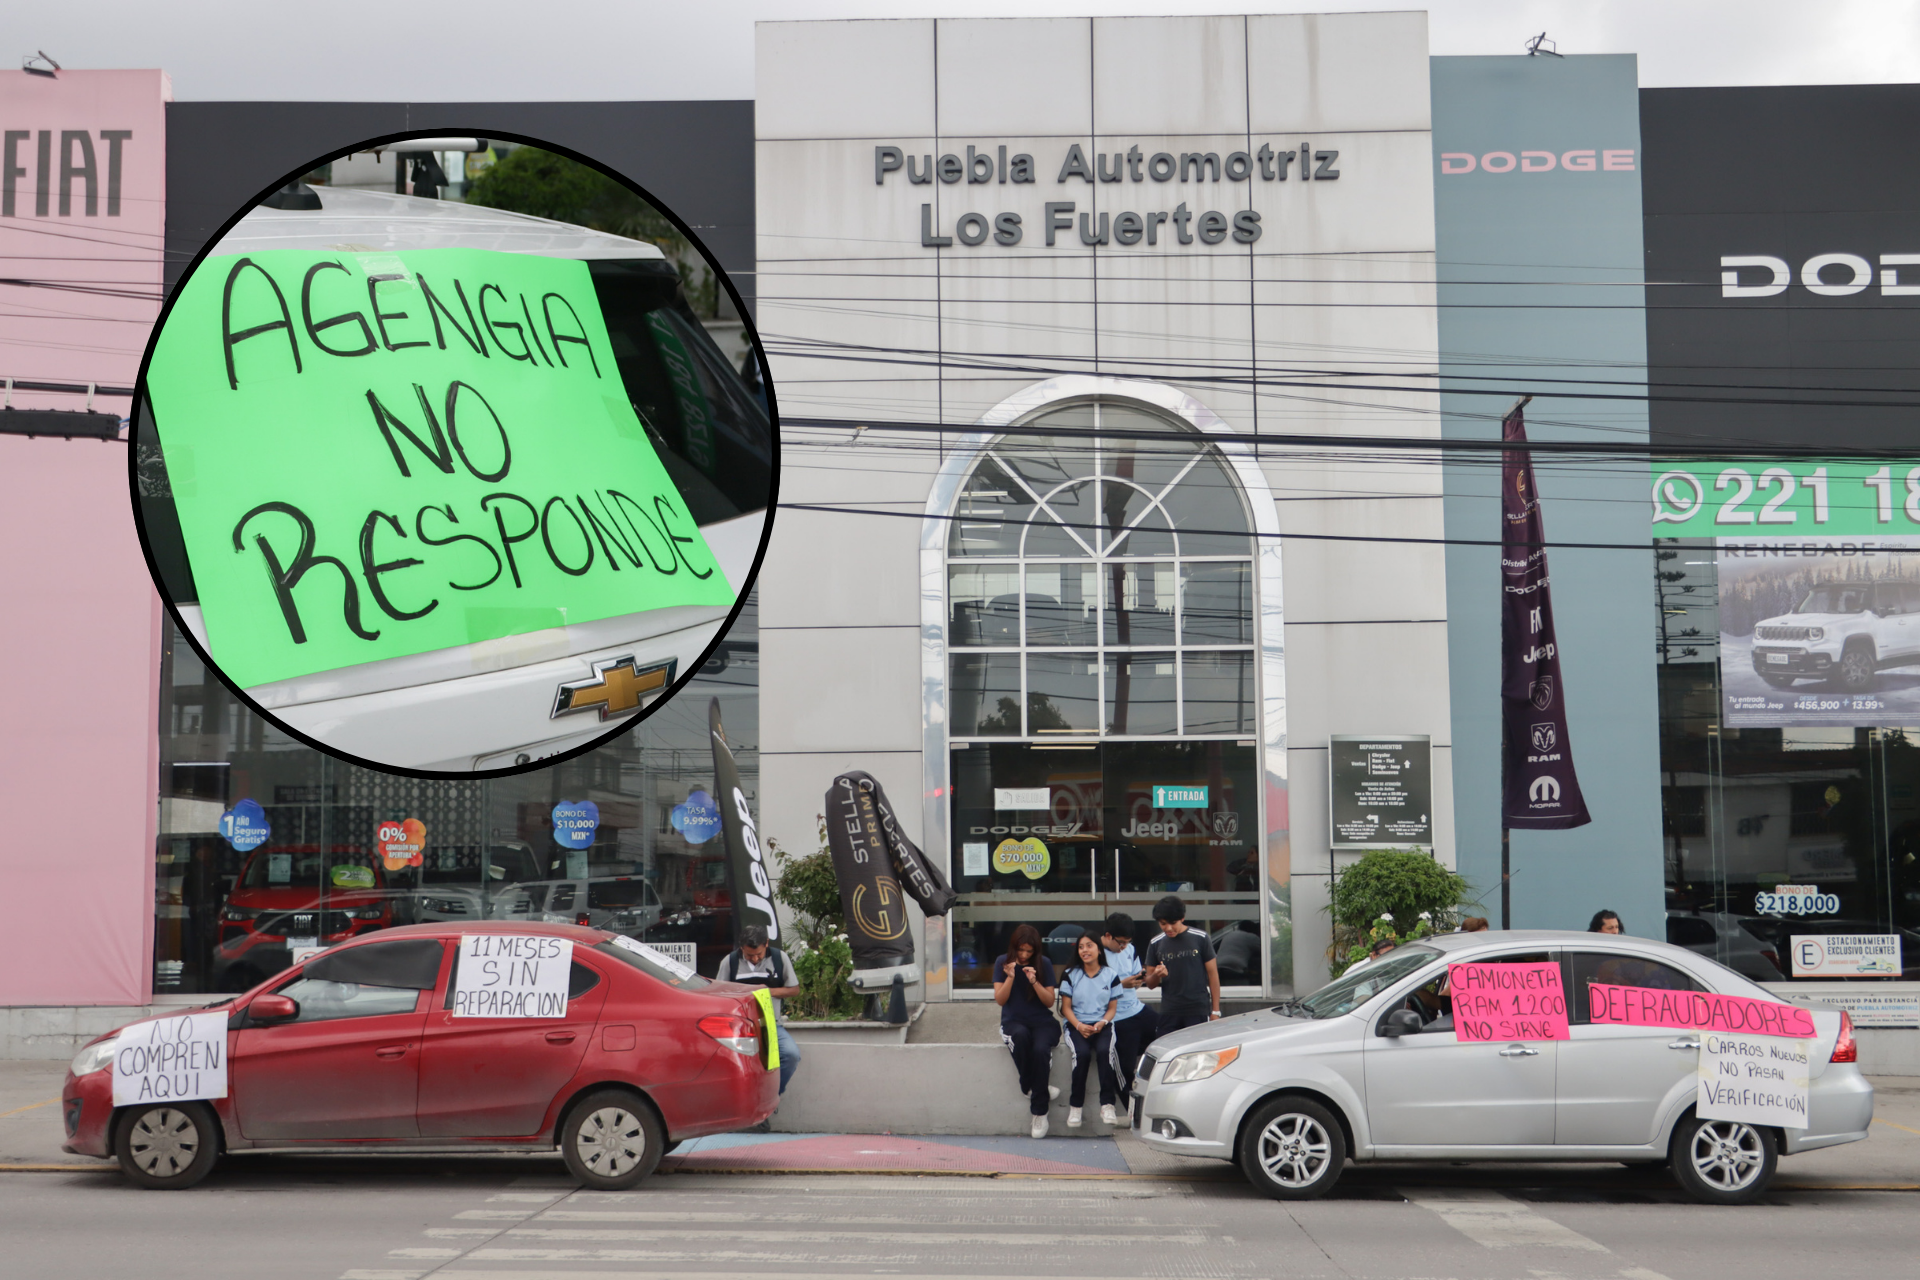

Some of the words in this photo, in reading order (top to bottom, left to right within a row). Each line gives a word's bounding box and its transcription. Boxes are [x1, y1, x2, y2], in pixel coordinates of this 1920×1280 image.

[2, 130, 132, 217] FIAT
[874, 145, 1035, 185] Puebla
[1057, 141, 1340, 184] Automotriz
[1441, 149, 1635, 174] DODGE
[921, 203, 1023, 248] Los
[1044, 201, 1263, 247] Fuertes
[365, 380, 511, 483] NO
[1714, 467, 1830, 525] 221
[1724, 542, 1876, 557] RENEGADE
[231, 489, 713, 645] RESPONDE
[1767, 702, 1784, 710] Jeep
[1794, 701, 1840, 710] $456,900
[1527, 754, 1561, 763] RAM
[1168, 790, 1205, 802] ENTRADA
[223, 815, 234, 837] 1
[234, 827, 267, 837] Seguro
[557, 819, 595, 830] $10,000
[840, 778, 869, 864] STELLA
[970, 826, 1069, 835] DODGE
[1121, 819, 1178, 841] Jeep
[380, 827, 407, 842] 0%
[733, 787, 778, 941] Jeep
[1000, 853, 1043, 863] $70,000
[1776, 886, 1801, 894] BONO
[1803, 886, 1814, 894] DE
[1755, 894, 1836, 916] $218,000
[470, 937, 497, 958] 11
[500, 937, 561, 960] MESES
[1802, 944, 1815, 965] E
[1827, 937, 1895, 945] ESTACIONAMIENTO
[1827, 947, 1863, 955] EXCLUSIVO
[1865, 946, 1895, 955] CLIENTES
[483, 961, 538, 986] SIN
[1449, 966, 1558, 992] CAMIONETA
[455, 990, 565, 1017] REPARACION
[1458, 994, 1501, 1018] RAM
[1512, 991, 1564, 1017] 1200
[1592, 987, 1815, 1036] DEFRAUDADORES
[151, 1016, 193, 1044] NO
[1463, 1020, 1492, 1040] NO
[1502, 1020, 1554, 1038] SIRVE
[119, 1041, 219, 1077] COMPREN
[1707, 1036, 1764, 1057] CARROS
[1770, 1045, 1808, 1064] NUEVOS
[1719, 1061, 1738, 1076] NO
[1744, 1061, 1784, 1080] PASAN
[139, 1072, 199, 1100] AQUI
[1704, 1080, 1805, 1115] VERIFICACIÓN
